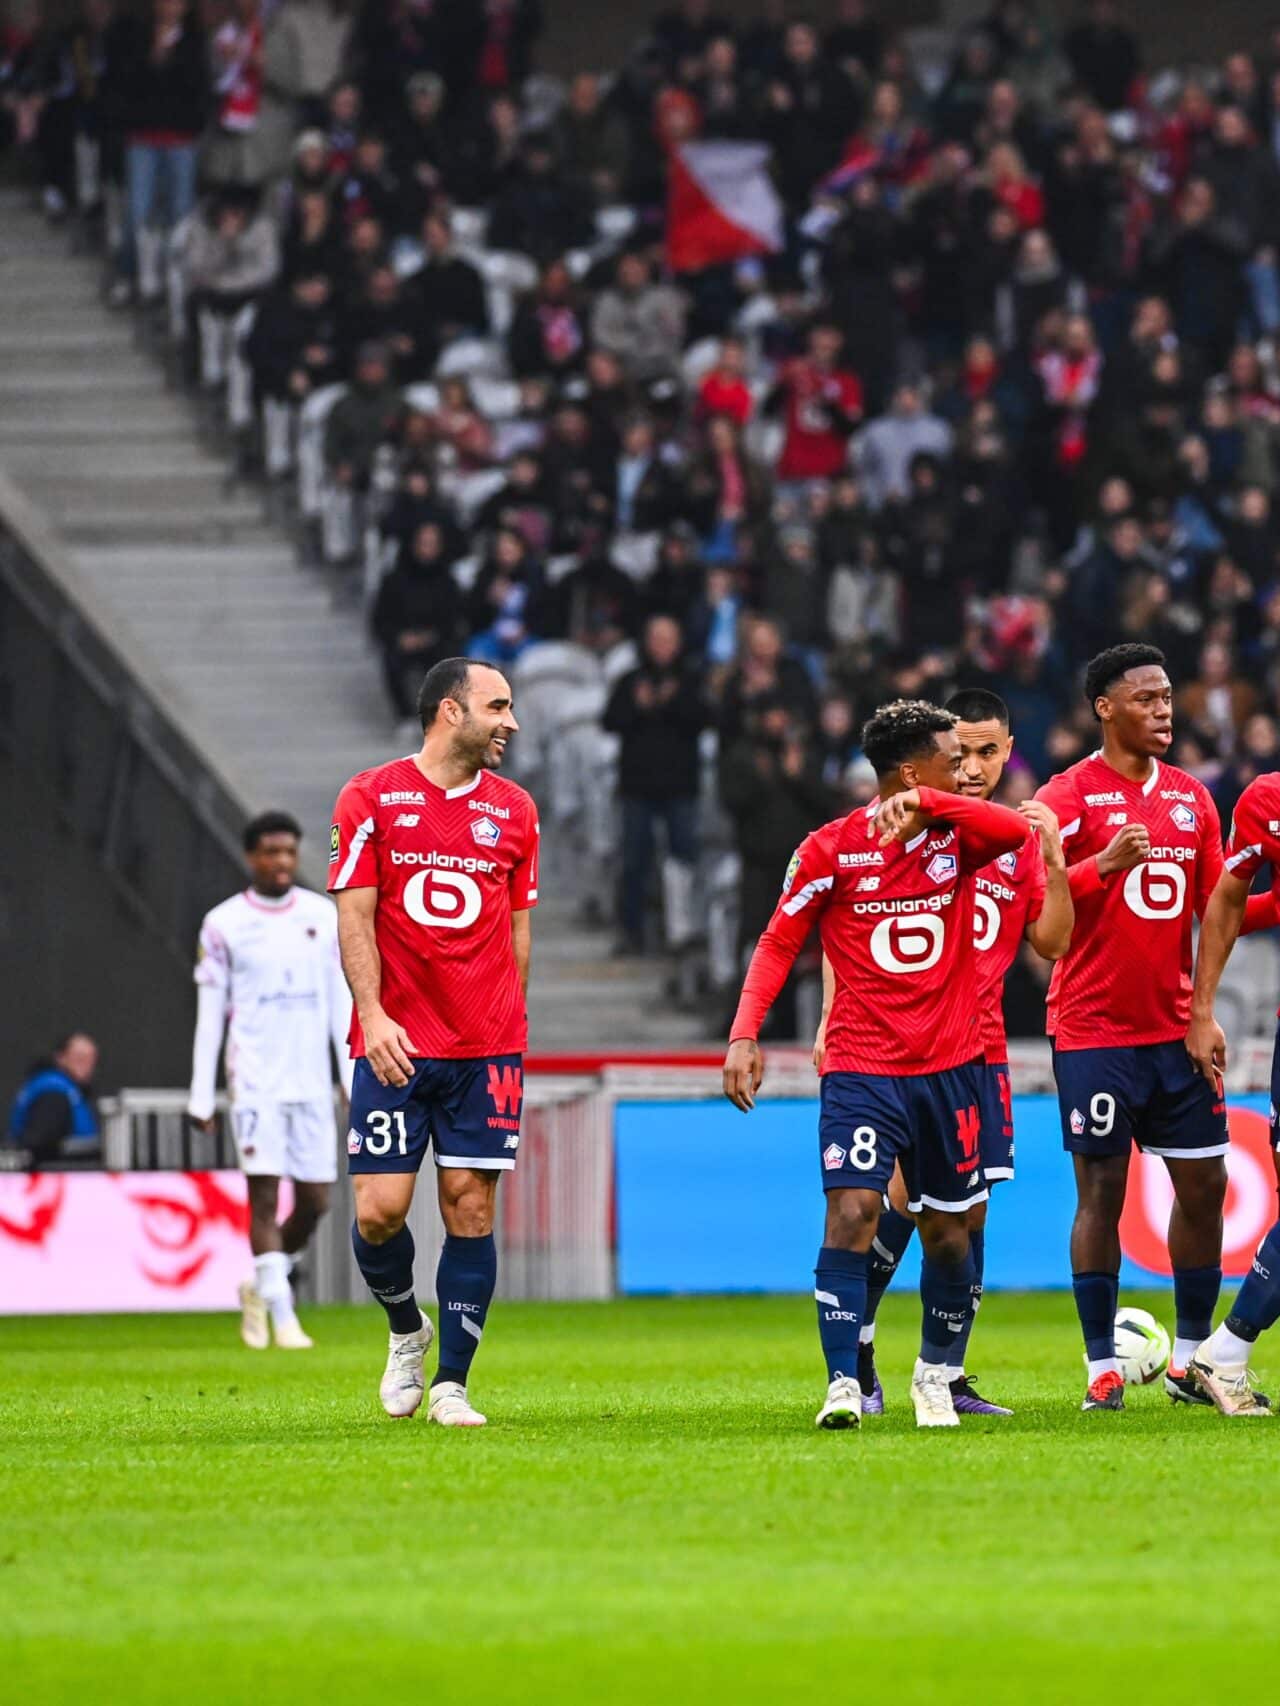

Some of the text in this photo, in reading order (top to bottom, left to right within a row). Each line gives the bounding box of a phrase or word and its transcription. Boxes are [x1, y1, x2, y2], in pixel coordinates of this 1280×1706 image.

[1160, 790, 1196, 803] actual
[468, 799, 510, 820] actual
[390, 850, 497, 874] boulanger
[1090, 1092, 1116, 1137] 9
[365, 1110, 407, 1156] 31
[849, 1125, 877, 1170] 8
[448, 1301, 481, 1314] LOSC
[825, 1310, 858, 1323] LOSC
